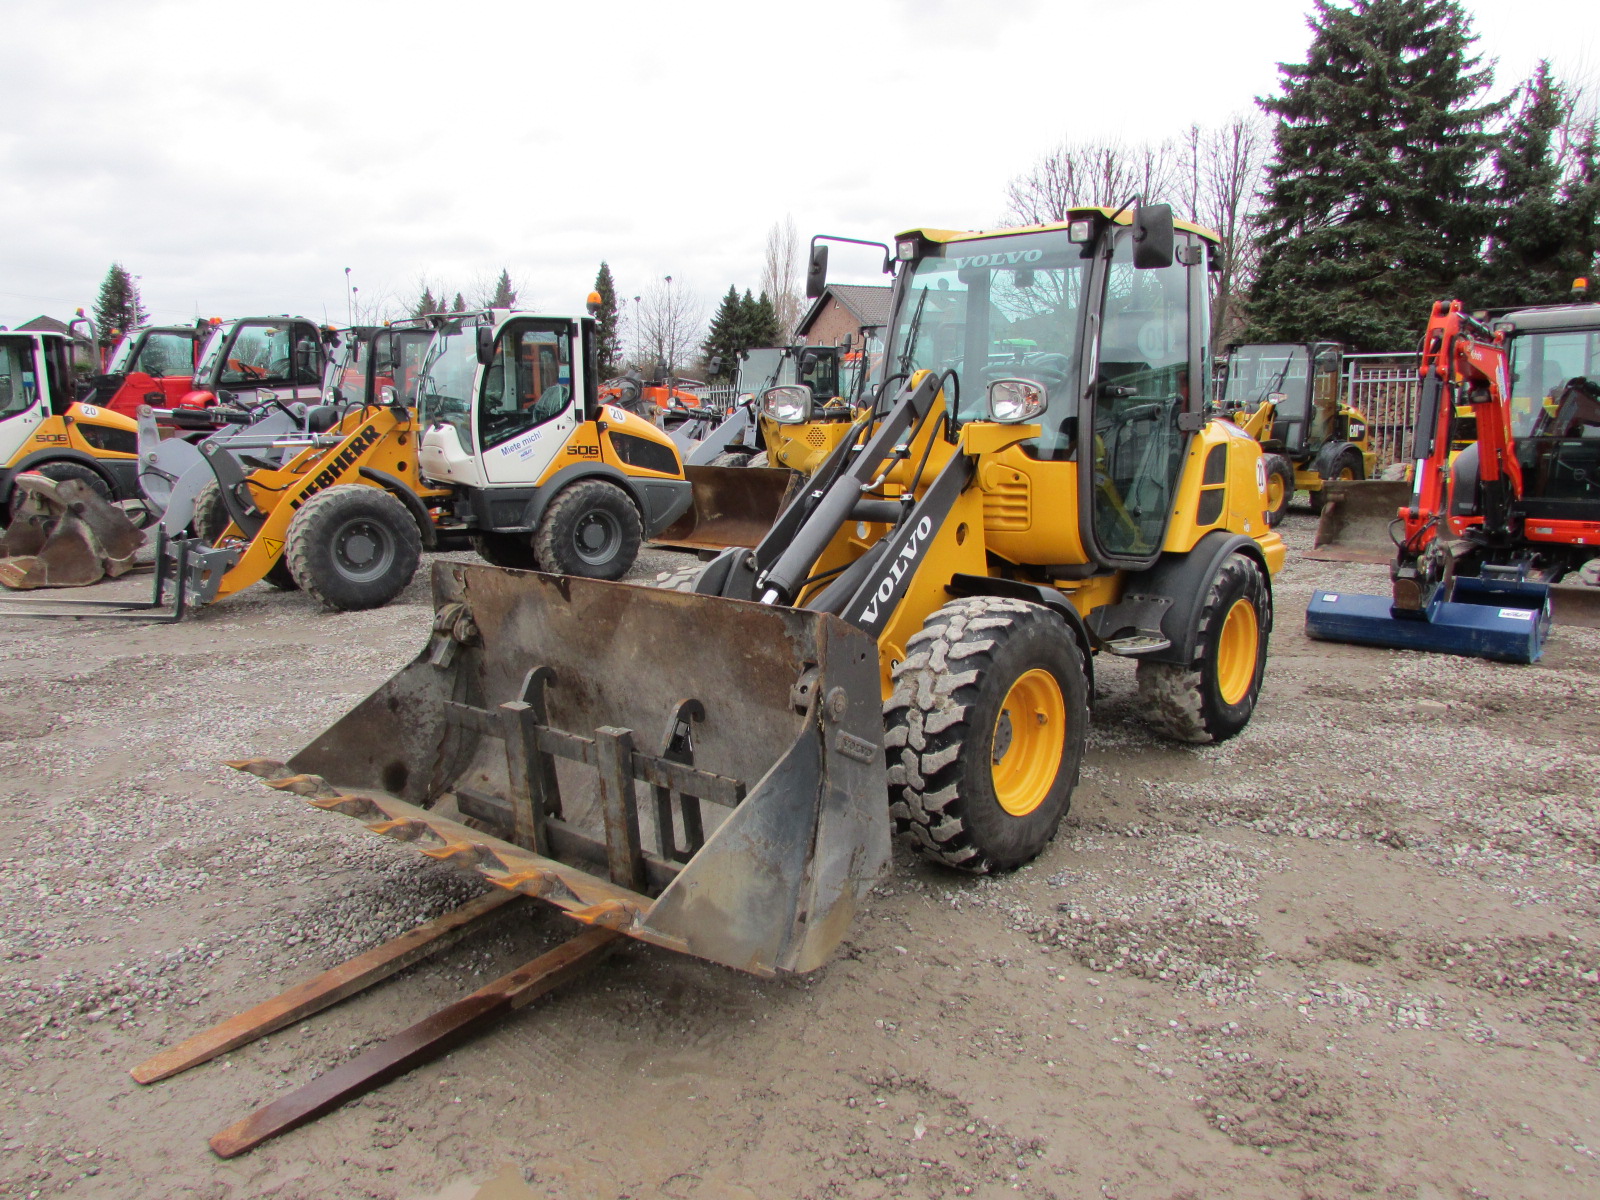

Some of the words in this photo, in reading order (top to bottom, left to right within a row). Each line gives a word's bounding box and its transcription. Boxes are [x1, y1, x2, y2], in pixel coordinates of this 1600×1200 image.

[952, 249, 1043, 270] VOLVO
[83, 405, 97, 416] 20
[610, 407, 624, 421] 20
[35, 434, 68, 442] 506
[1350, 424, 1359, 438] CAT
[500, 442, 522, 457] Miete
[521, 430, 543, 447] mich!
[566, 445, 599, 456] 506
[858, 515, 932, 624] VOLVO
